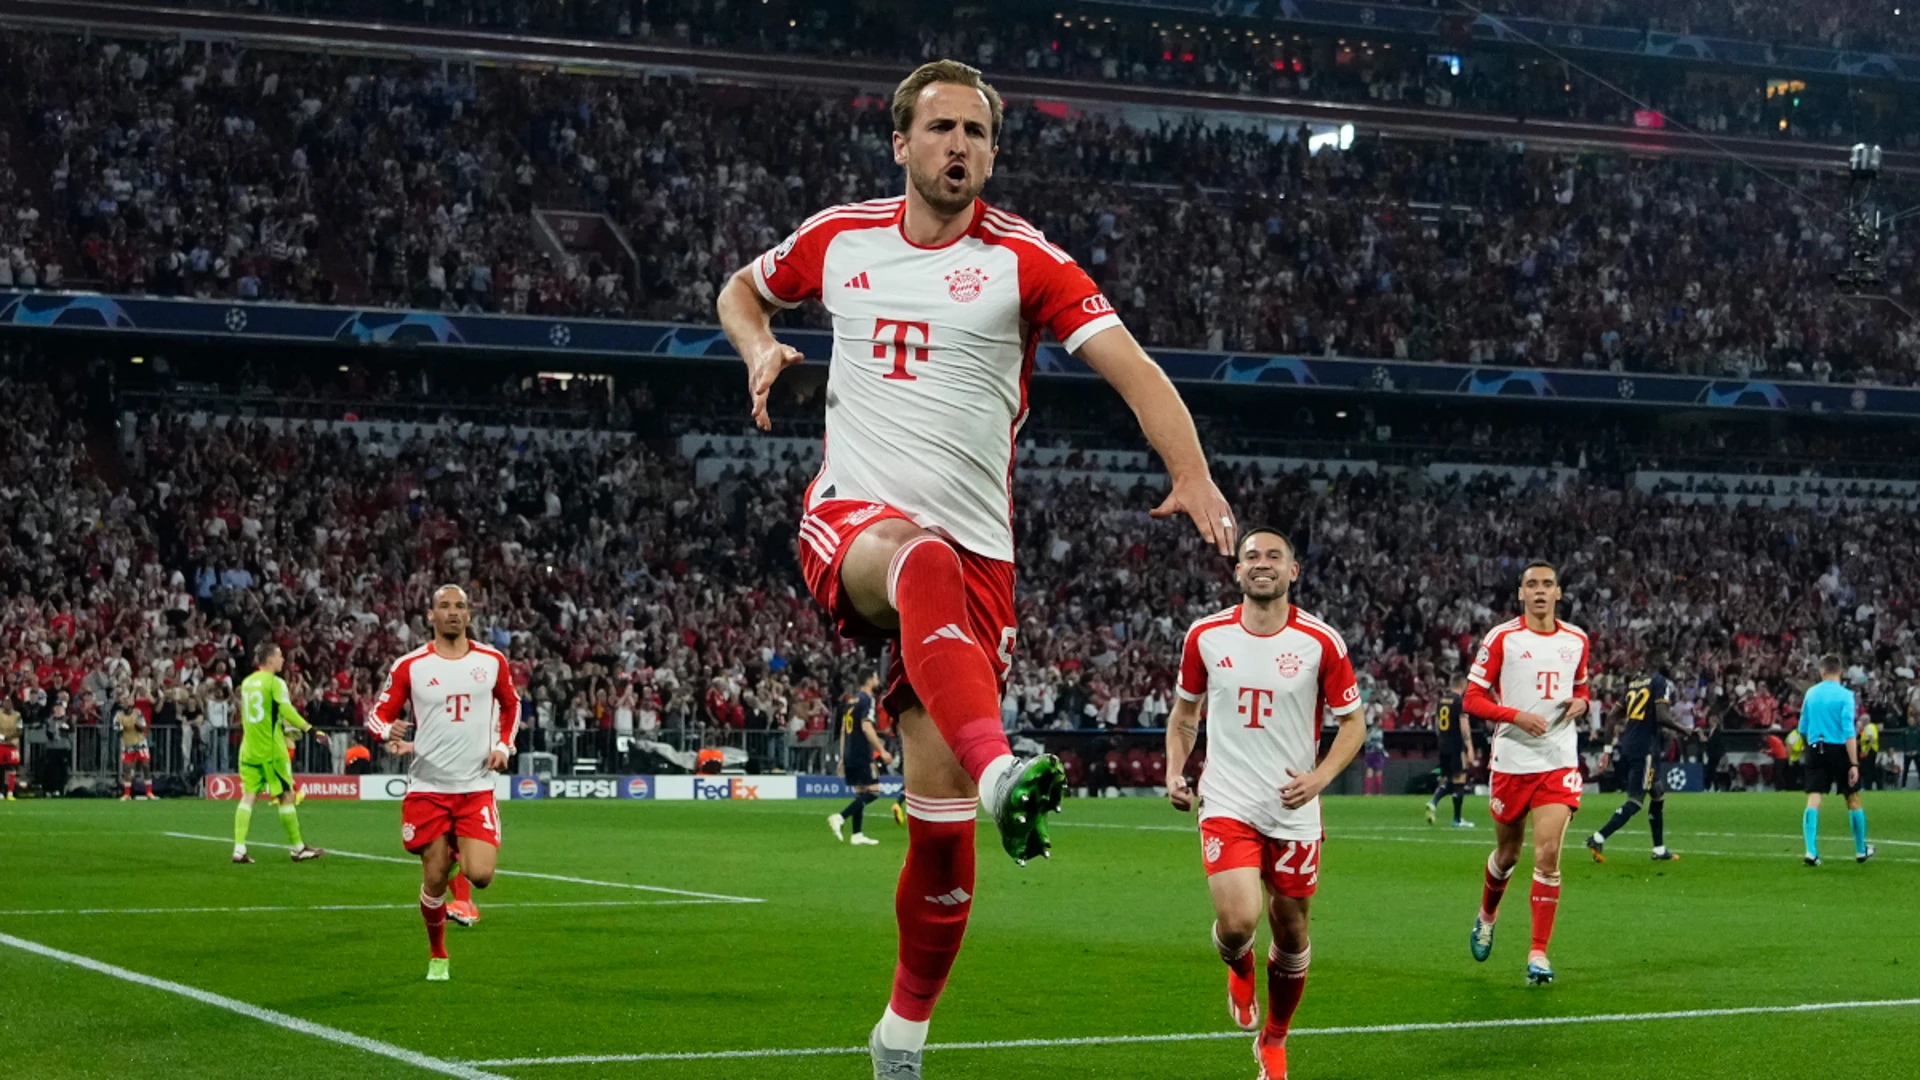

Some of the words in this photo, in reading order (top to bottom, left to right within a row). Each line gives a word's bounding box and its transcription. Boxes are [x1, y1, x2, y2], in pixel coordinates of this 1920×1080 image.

[873, 318, 929, 381] T
[1536, 671, 1560, 700] T
[242, 691, 265, 724] 13
[446, 693, 471, 723] T
[1238, 686, 1274, 729] T
[1439, 704, 1450, 732] 8
[1625, 688, 1651, 721] 22
[301, 783, 357, 796] AIRLINES
[549, 779, 617, 798] PEPSI
[693, 777, 759, 799] FedEx
[805, 783, 840, 794] ROAD
[1275, 841, 1317, 874] 22
